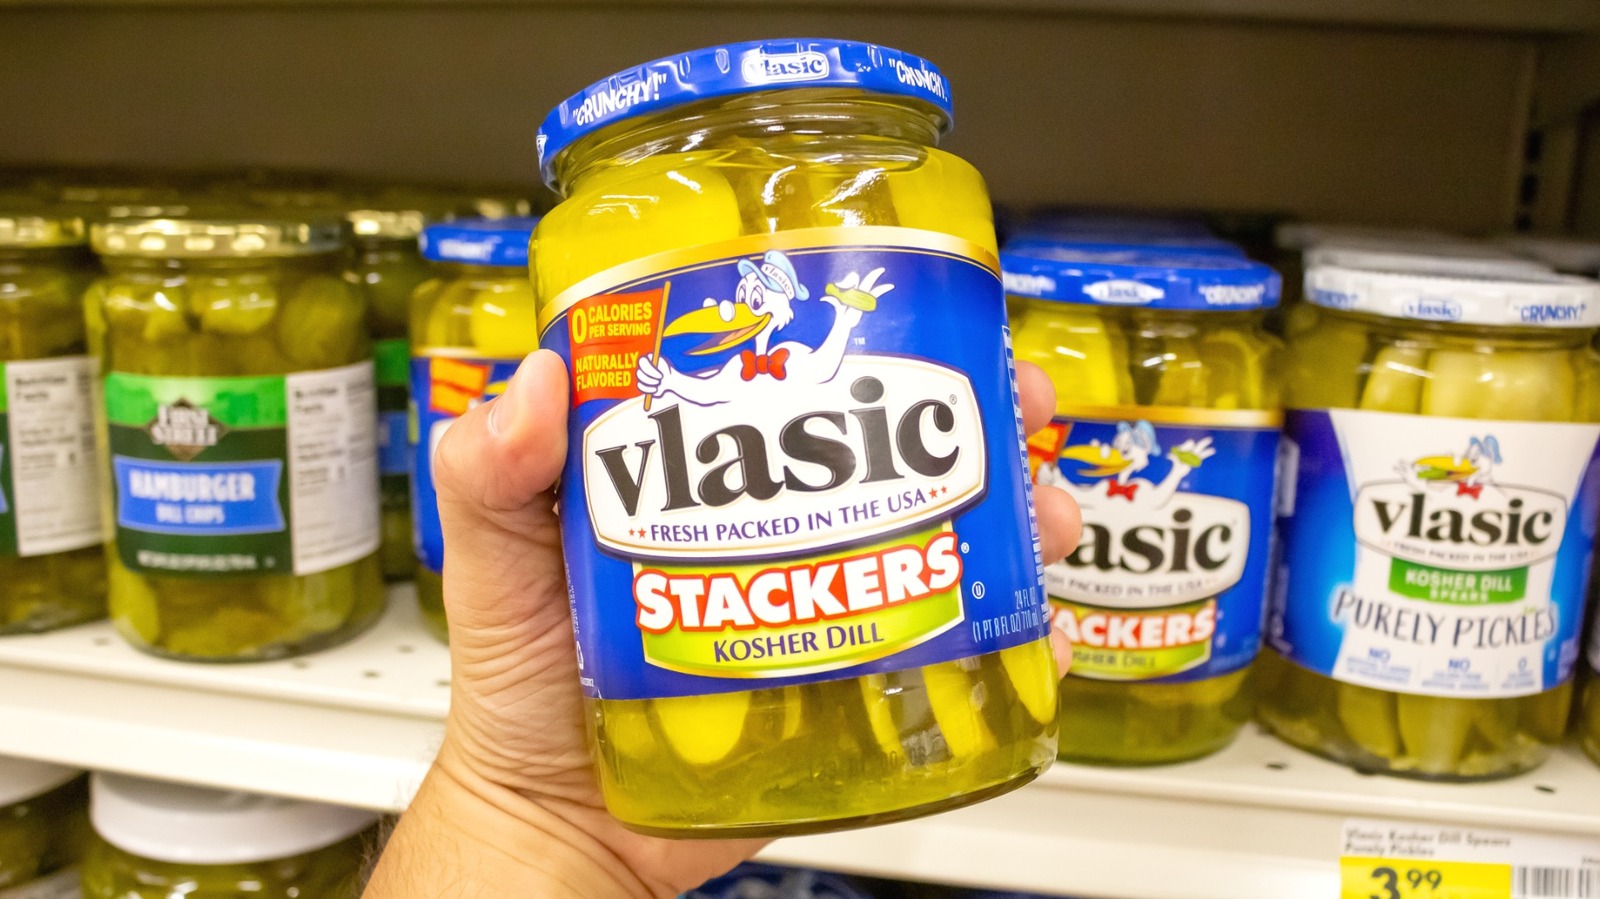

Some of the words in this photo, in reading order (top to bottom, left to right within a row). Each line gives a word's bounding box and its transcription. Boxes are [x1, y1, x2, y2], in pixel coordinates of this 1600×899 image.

[572, 308, 587, 344] 0
[588, 301, 653, 324] CALORIES
[589, 324, 605, 339] PER
[607, 321, 651, 337] SERVING
[575, 351, 639, 374] NATURALLY
[576, 370, 632, 392] FLAVORED
[595, 376, 960, 517] vlasic
[129, 470, 256, 502] HAMBURGER
[651, 523, 709, 543] FRESH
[716, 516, 800, 541] PACKED
[808, 511, 833, 531] IN
[838, 500, 881, 526] THE
[887, 489, 927, 514] USA
[1371, 493, 1553, 546] vlasic
[1065, 508, 1232, 574] asic
[634, 533, 961, 632] STACKERS
[1405, 569, 1477, 591] KOSHER
[1480, 575, 1513, 593] DILL
[983, 619, 993, 640] PT
[994, 617, 1001, 637] 8
[1001, 615, 1010, 636] FL
[1049, 606, 1215, 649] ACKERS
[1335, 590, 1445, 645] PURELY
[1452, 607, 1556, 649] PICKLES
[713, 632, 820, 663] KOSHER
[828, 622, 884, 652] DILL
[1370, 866, 1401, 899] 3
[1406, 869, 1442, 890] 99
